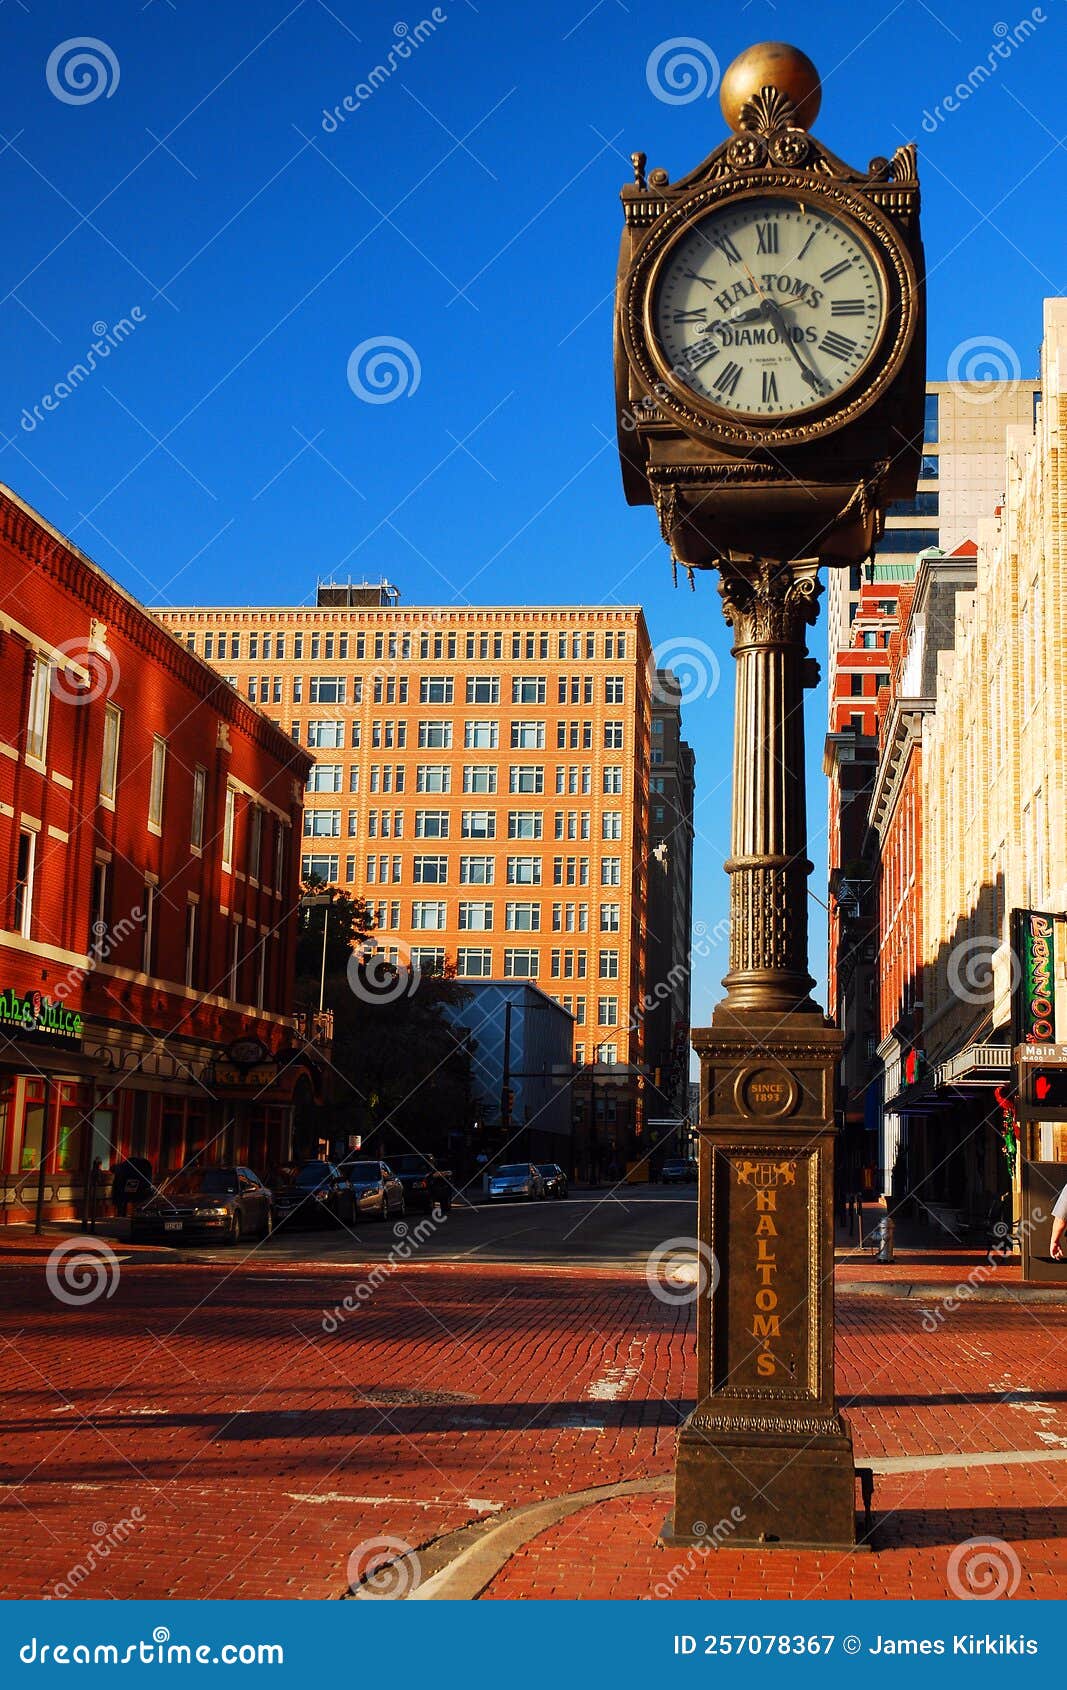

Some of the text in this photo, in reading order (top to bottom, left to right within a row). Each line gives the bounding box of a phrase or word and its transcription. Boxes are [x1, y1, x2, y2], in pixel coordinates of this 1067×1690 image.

[756, 223, 778, 254] XII
[40, 996, 82, 1033] Juice
[1026, 1046, 1055, 1056] Main
[751, 1084, 784, 1093] SINCE
[754, 1093, 780, 1102] 1893
[752, 1190, 781, 1376] HALTOM'S
